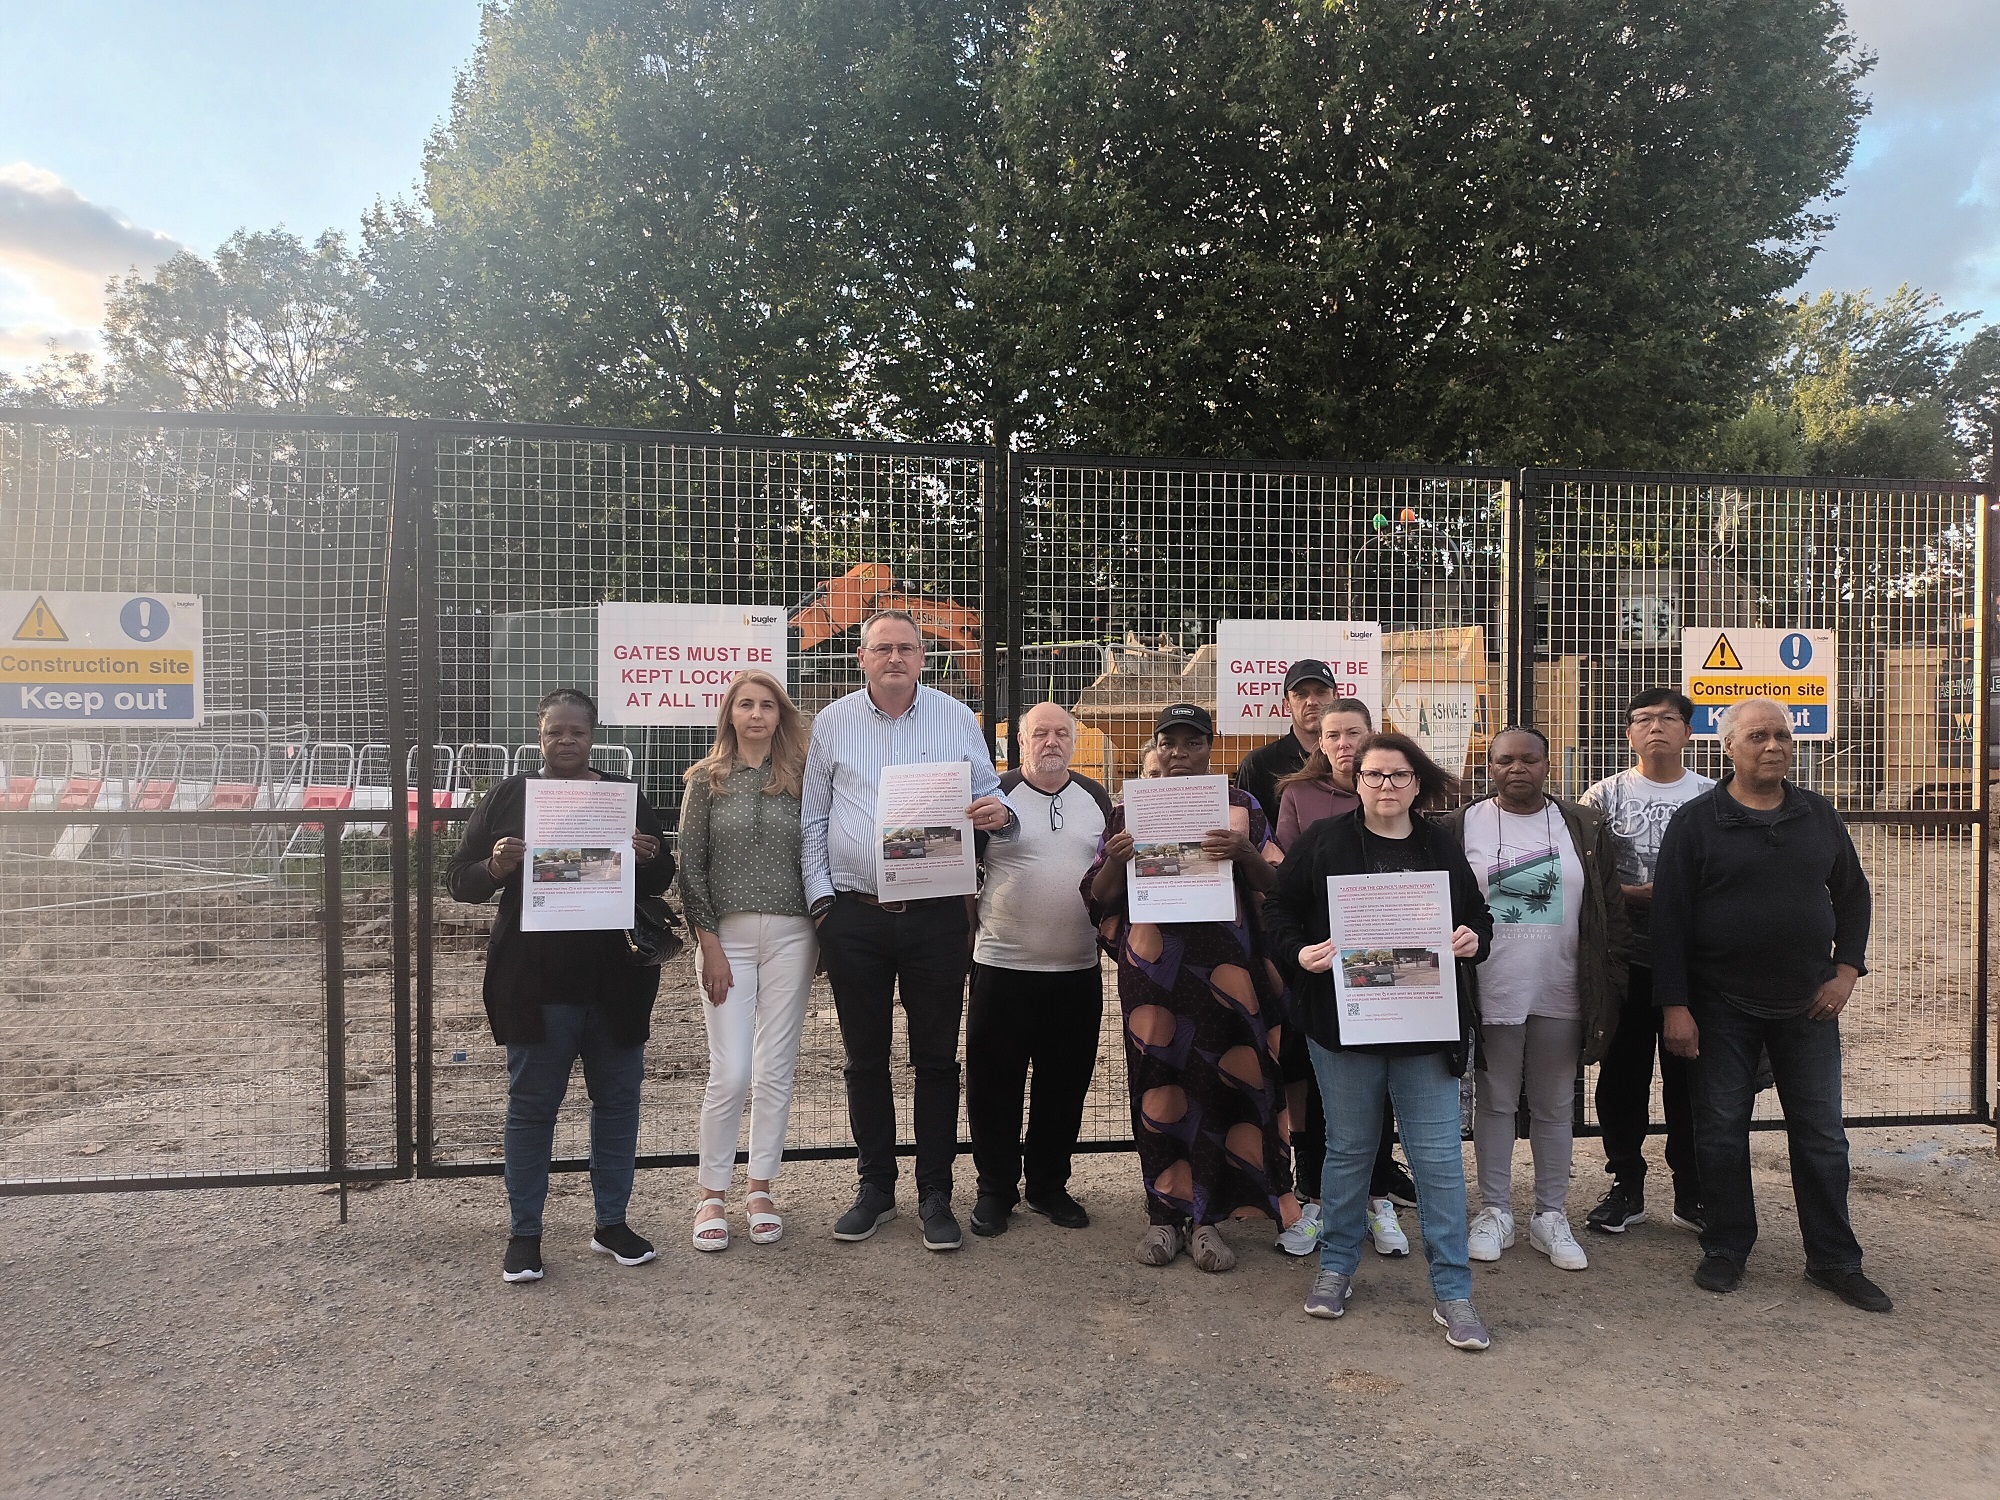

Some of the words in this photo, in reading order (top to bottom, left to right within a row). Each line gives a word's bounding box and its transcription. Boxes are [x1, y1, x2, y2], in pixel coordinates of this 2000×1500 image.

[751, 614, 777, 624] bugler
[1350, 631, 1373, 640] bugler
[614, 645, 680, 661] GATES
[687, 647, 741, 662] MUST
[747, 648, 773, 663] BE
[1, 655, 139, 674] Construction
[149, 658, 190, 674] site
[1230, 660, 1288, 674] GATES
[1346, 661, 1369, 675] BE
[621, 669, 673, 684] KEPT
[680, 670, 742, 685] LOCK
[1237, 682, 1282, 696] KEPT
[1693, 681, 1791, 696] Construction
[1797, 683, 1825, 696] site
[21, 686, 104, 716] Keep
[114, 688, 168, 710] out
[626, 692, 653, 707] AT
[658, 693, 696, 708] ALL
[1241, 703, 1264, 718] AT
[1268, 703, 1292, 718] AL
